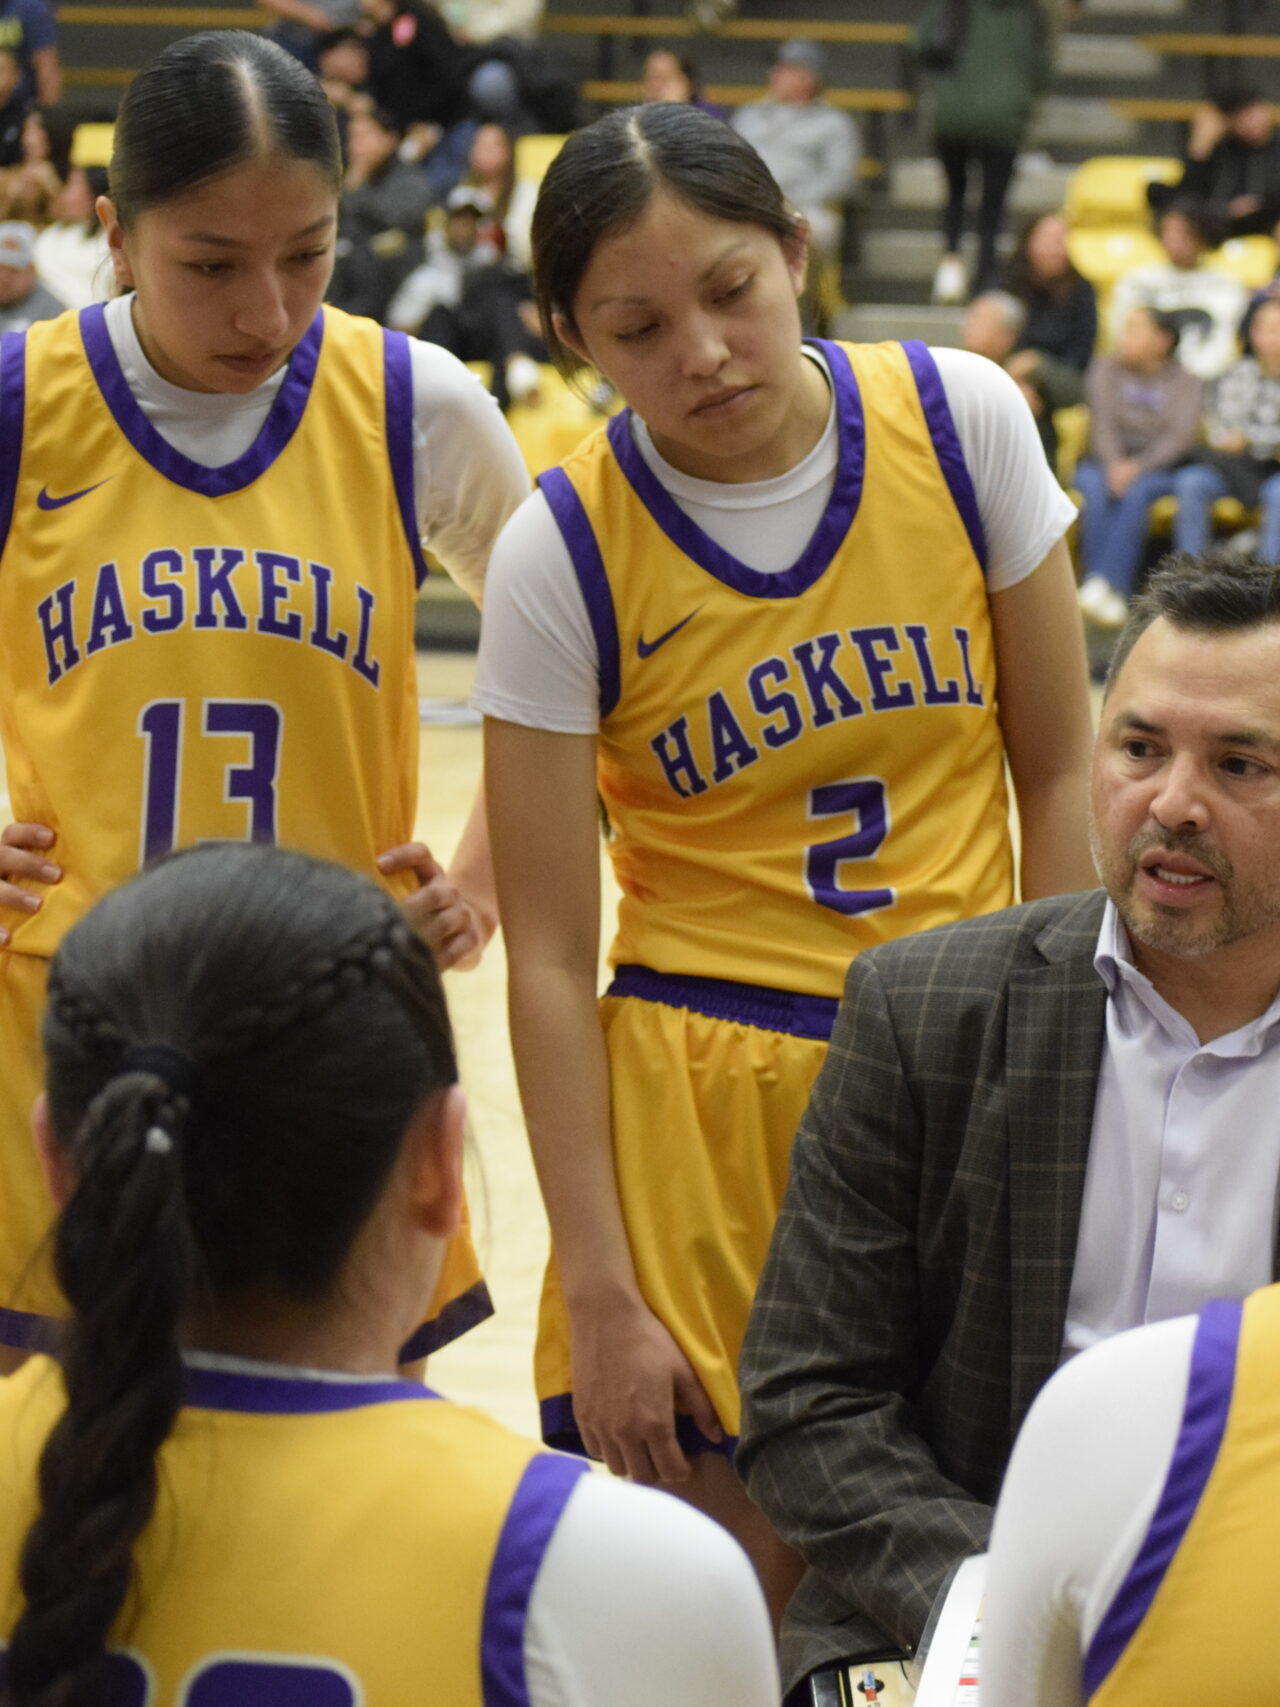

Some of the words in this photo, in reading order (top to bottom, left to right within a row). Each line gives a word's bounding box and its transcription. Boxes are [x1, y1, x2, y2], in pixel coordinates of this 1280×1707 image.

[36, 546, 381, 690] HASKELL
[137, 697, 284, 871] 13
[649, 623, 986, 799] HASKELL
[803, 774, 897, 918] 2
